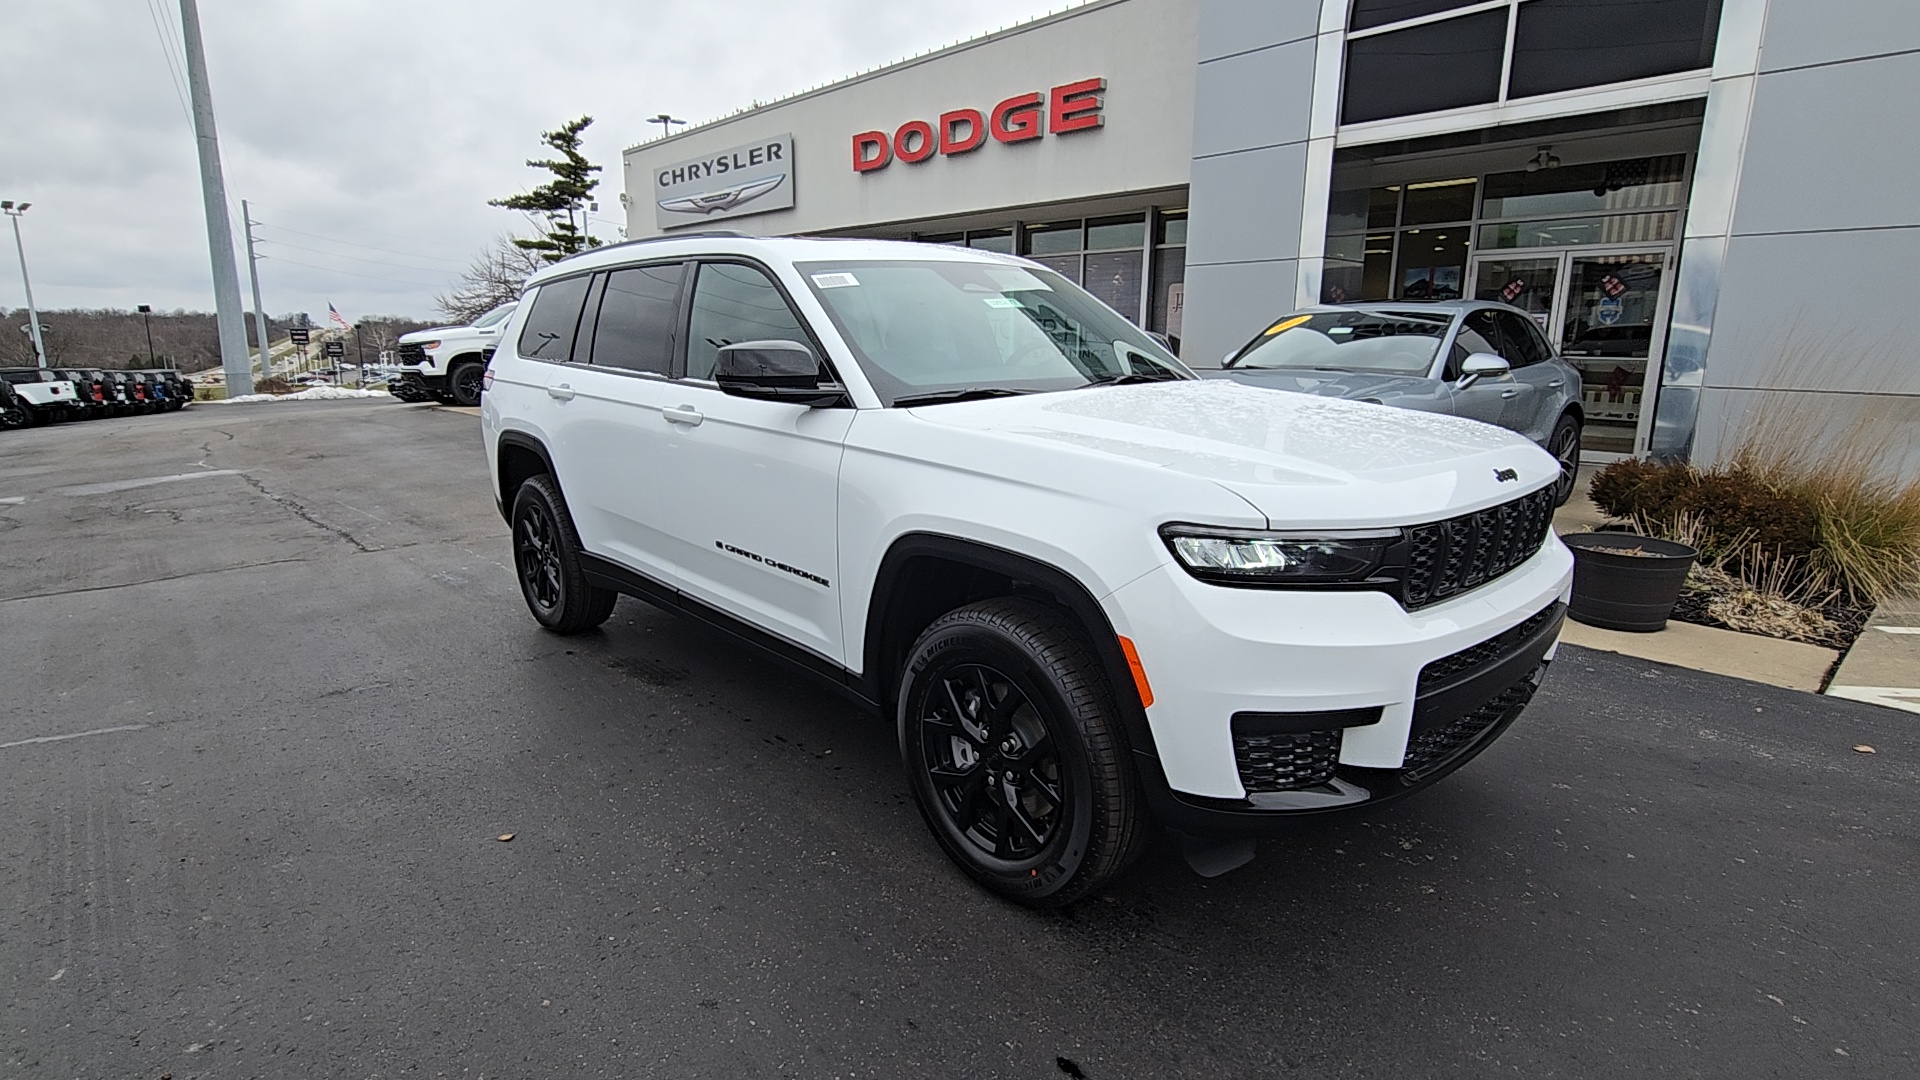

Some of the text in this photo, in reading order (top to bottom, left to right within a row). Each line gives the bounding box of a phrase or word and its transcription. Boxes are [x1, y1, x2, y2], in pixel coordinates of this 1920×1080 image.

[852, 77, 1107, 173] DODGE
[658, 142, 783, 187] CHRYSLER
[724, 544, 830, 588] GRAND CHEROKEE
[926, 636, 972, 658] MICHEL
